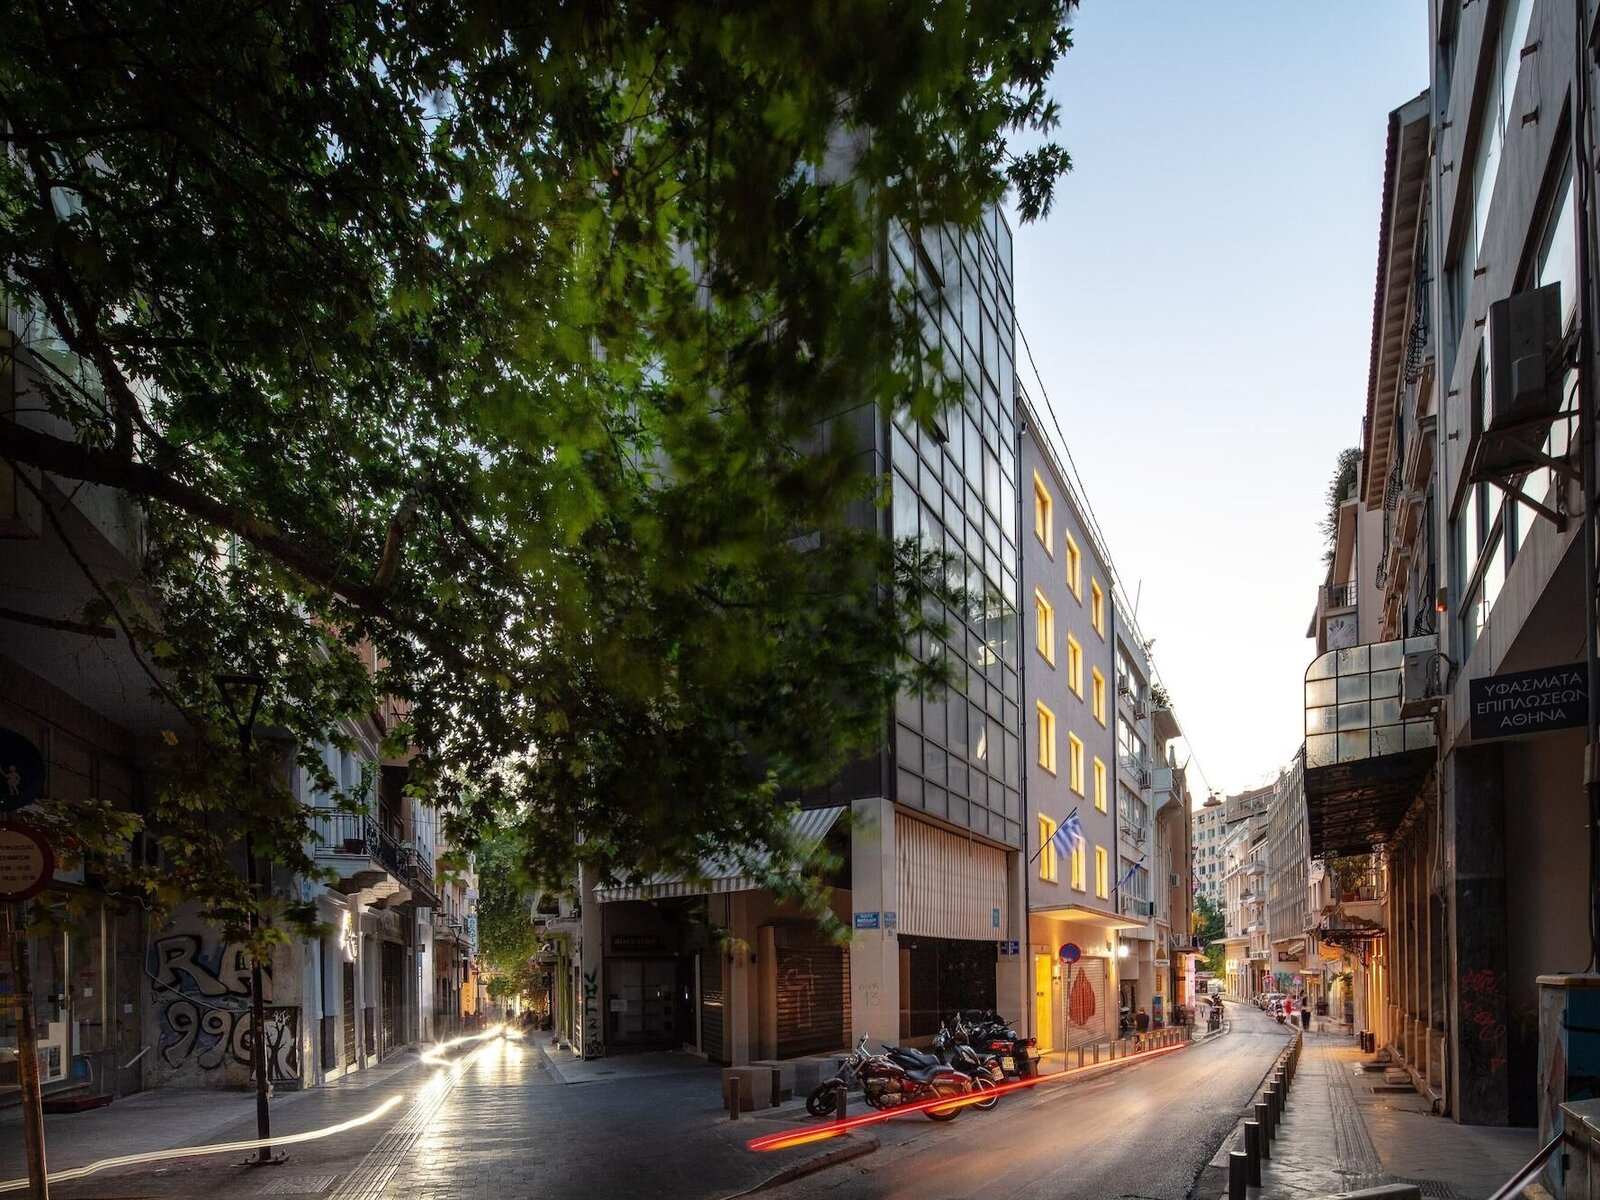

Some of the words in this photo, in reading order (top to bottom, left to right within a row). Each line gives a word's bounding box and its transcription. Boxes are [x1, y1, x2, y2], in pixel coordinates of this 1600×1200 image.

[1485, 672, 1582, 697] ΥΦΑΣΜΑΤΑ
[1477, 689, 1589, 715] ΕΠΙΠΛΩΣΕΩΝ
[1500, 708, 1566, 728] ΑΘΗΝΑ
